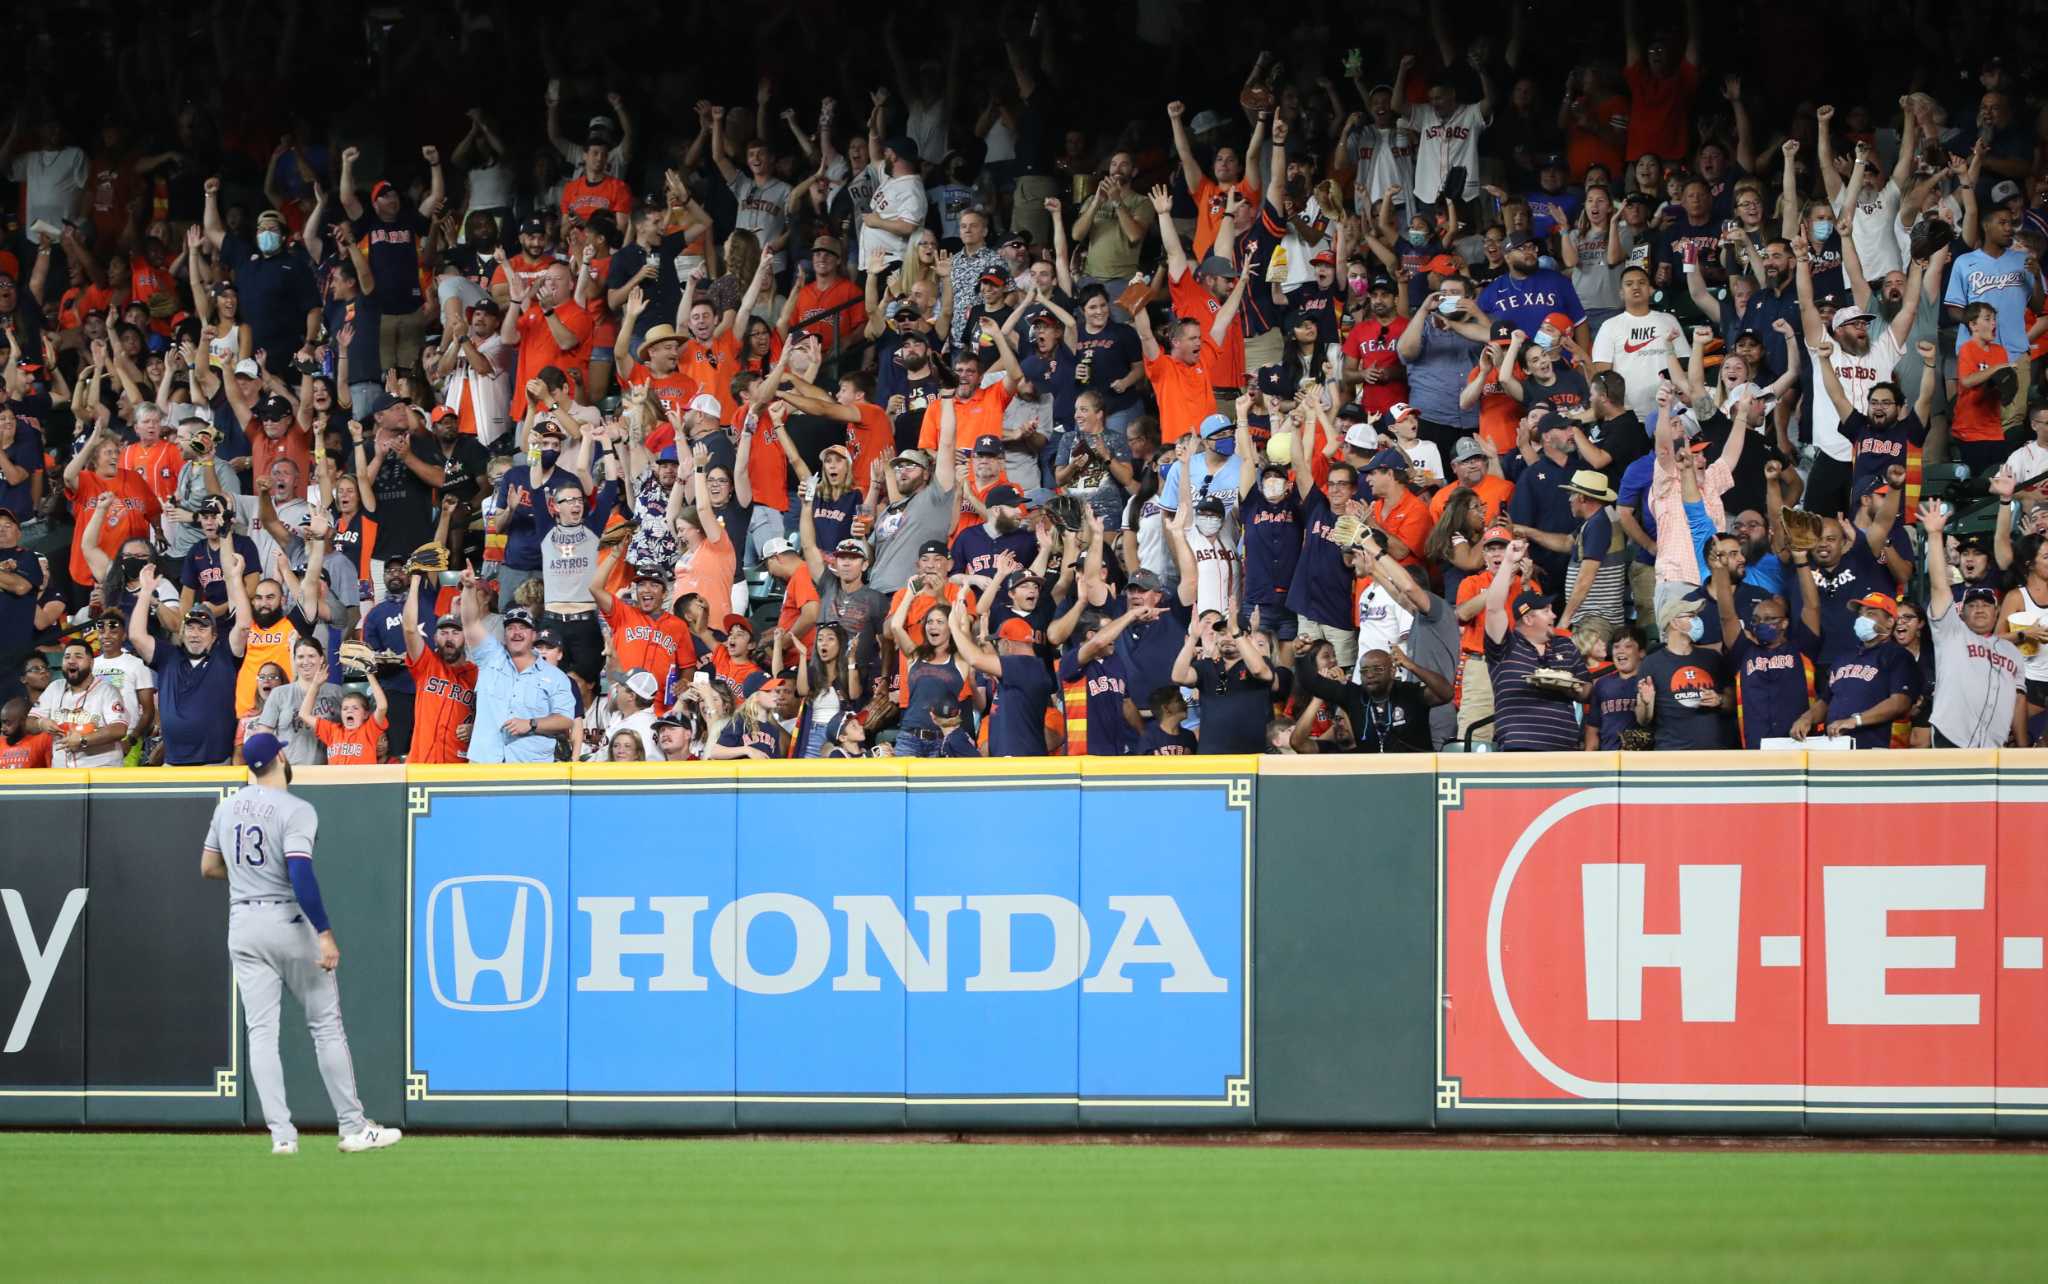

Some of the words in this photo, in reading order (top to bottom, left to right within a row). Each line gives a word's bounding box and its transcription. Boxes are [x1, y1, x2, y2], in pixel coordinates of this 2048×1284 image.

[1968, 269, 2027, 295] Rangers
[1495, 292, 1556, 312] TEXAS
[1631, 326, 1658, 341] NIKE
[551, 557, 589, 571] ASTROS
[625, 625, 679, 657] ASTROS
[232, 821, 265, 868] 13
[577, 892, 1228, 995] HONDA
[0, 888, 89, 1053] y
